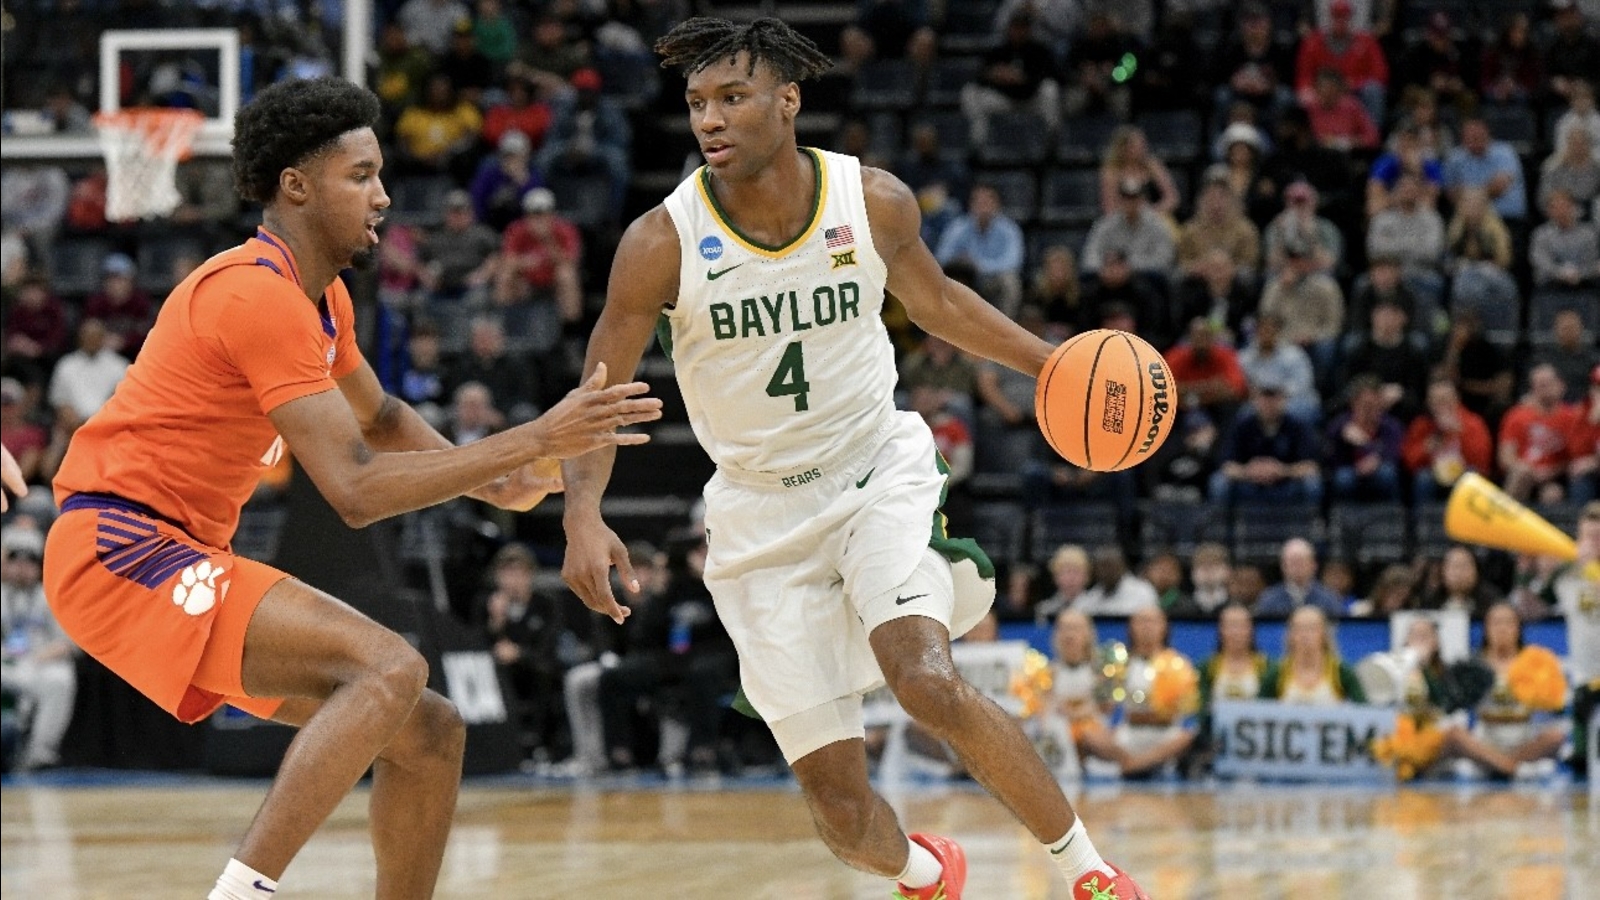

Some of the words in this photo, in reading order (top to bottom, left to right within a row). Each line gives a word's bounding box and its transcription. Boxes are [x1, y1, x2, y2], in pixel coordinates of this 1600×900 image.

[831, 250, 856, 270] XII
[709, 281, 860, 340] BAYLOR
[765, 340, 811, 412] 4
[1136, 362, 1169, 455] Wilson
[781, 467, 822, 488] BEARS
[1235, 717, 1305, 762] SIC
